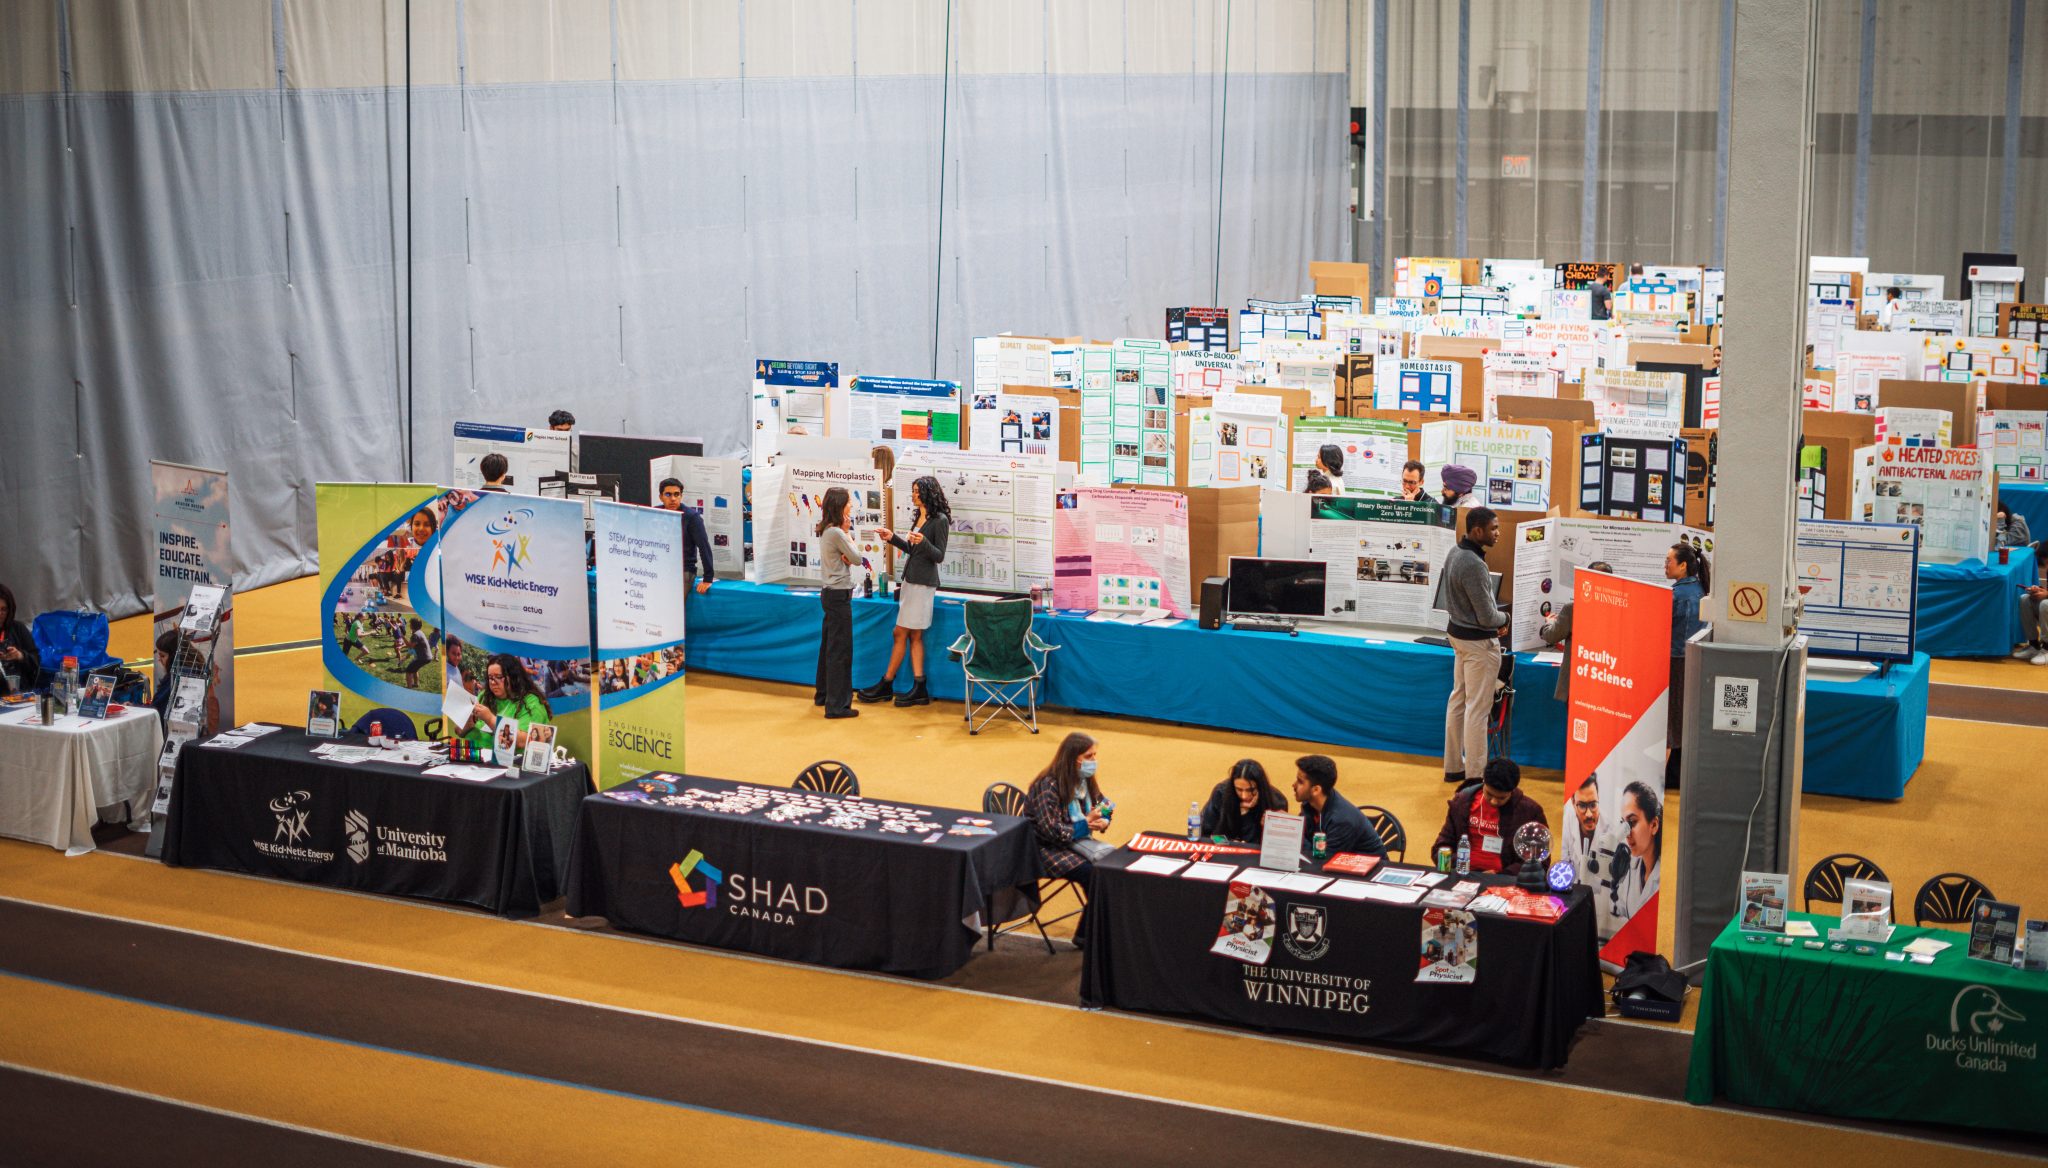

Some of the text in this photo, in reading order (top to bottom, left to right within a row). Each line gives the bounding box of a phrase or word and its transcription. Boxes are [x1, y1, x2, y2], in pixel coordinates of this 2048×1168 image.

[1503, 156, 1528, 175] EXIT
[1561, 324, 1589, 332] FLYING
[1557, 334, 1589, 342] POTATO
[1180, 350, 1202, 358] MAKES
[1196, 360, 1233, 370] UNIVERSAL
[1400, 362, 1452, 372] HOMEOSTASIS
[1455, 424, 1531, 441] WASH AWAY
[1456, 440, 1538, 457] THE WORRIES
[1899, 448, 1980, 466] HEATED SPICES:
[792, 469, 875, 481] Mapping Microplastics
[1879, 466, 1982, 481] ANTIBACTERIAL AGENT?
[1357, 502, 1375, 511] Binary
[160, 531, 199, 550] INSPIRE.
[609, 532, 670, 552] STEM programming
[160, 548, 204, 567] EDUCATE.
[609, 544, 631, 557] offered
[160, 564, 213, 585] ENTERTAIN.
[630, 567, 658, 579] Workshops
[465, 573, 558, 596] WISE Kid-Netic Energy
[630, 578, 647, 588] Camps
[630, 590, 644, 599] Clubs
[1594, 592, 1629, 608] WINNIPEG
[523, 606, 543, 615] actua
[630, 600, 646, 611] Events
[1578, 645, 1617, 670] Faculty
[1577, 664, 1633, 689] of Science
[608, 720, 672, 740] ENGINEERING
[616, 730, 672, 760] SCIENCE
[376, 827, 446, 849] University
[1138, 836, 1238, 852] UWINNIPEG
[253, 840, 334, 861] WISE Kid-Netic Energy
[377, 842, 447, 862] of Manitoba
[728, 874, 828, 915] SHAD
[730, 905, 795, 926] CANADA
[1226, 941, 1258, 957] Physicist
[1232, 937, 1246, 946] Spot
[1243, 964, 1371, 991] THE UNIVERSITY OF
[1430, 971, 1463, 980] Physicist
[1244, 980, 1370, 1014] WINNIPEG
[1926, 1034, 2037, 1059] Ducks Unlimited
[1956, 1052, 2007, 1072] Canada
